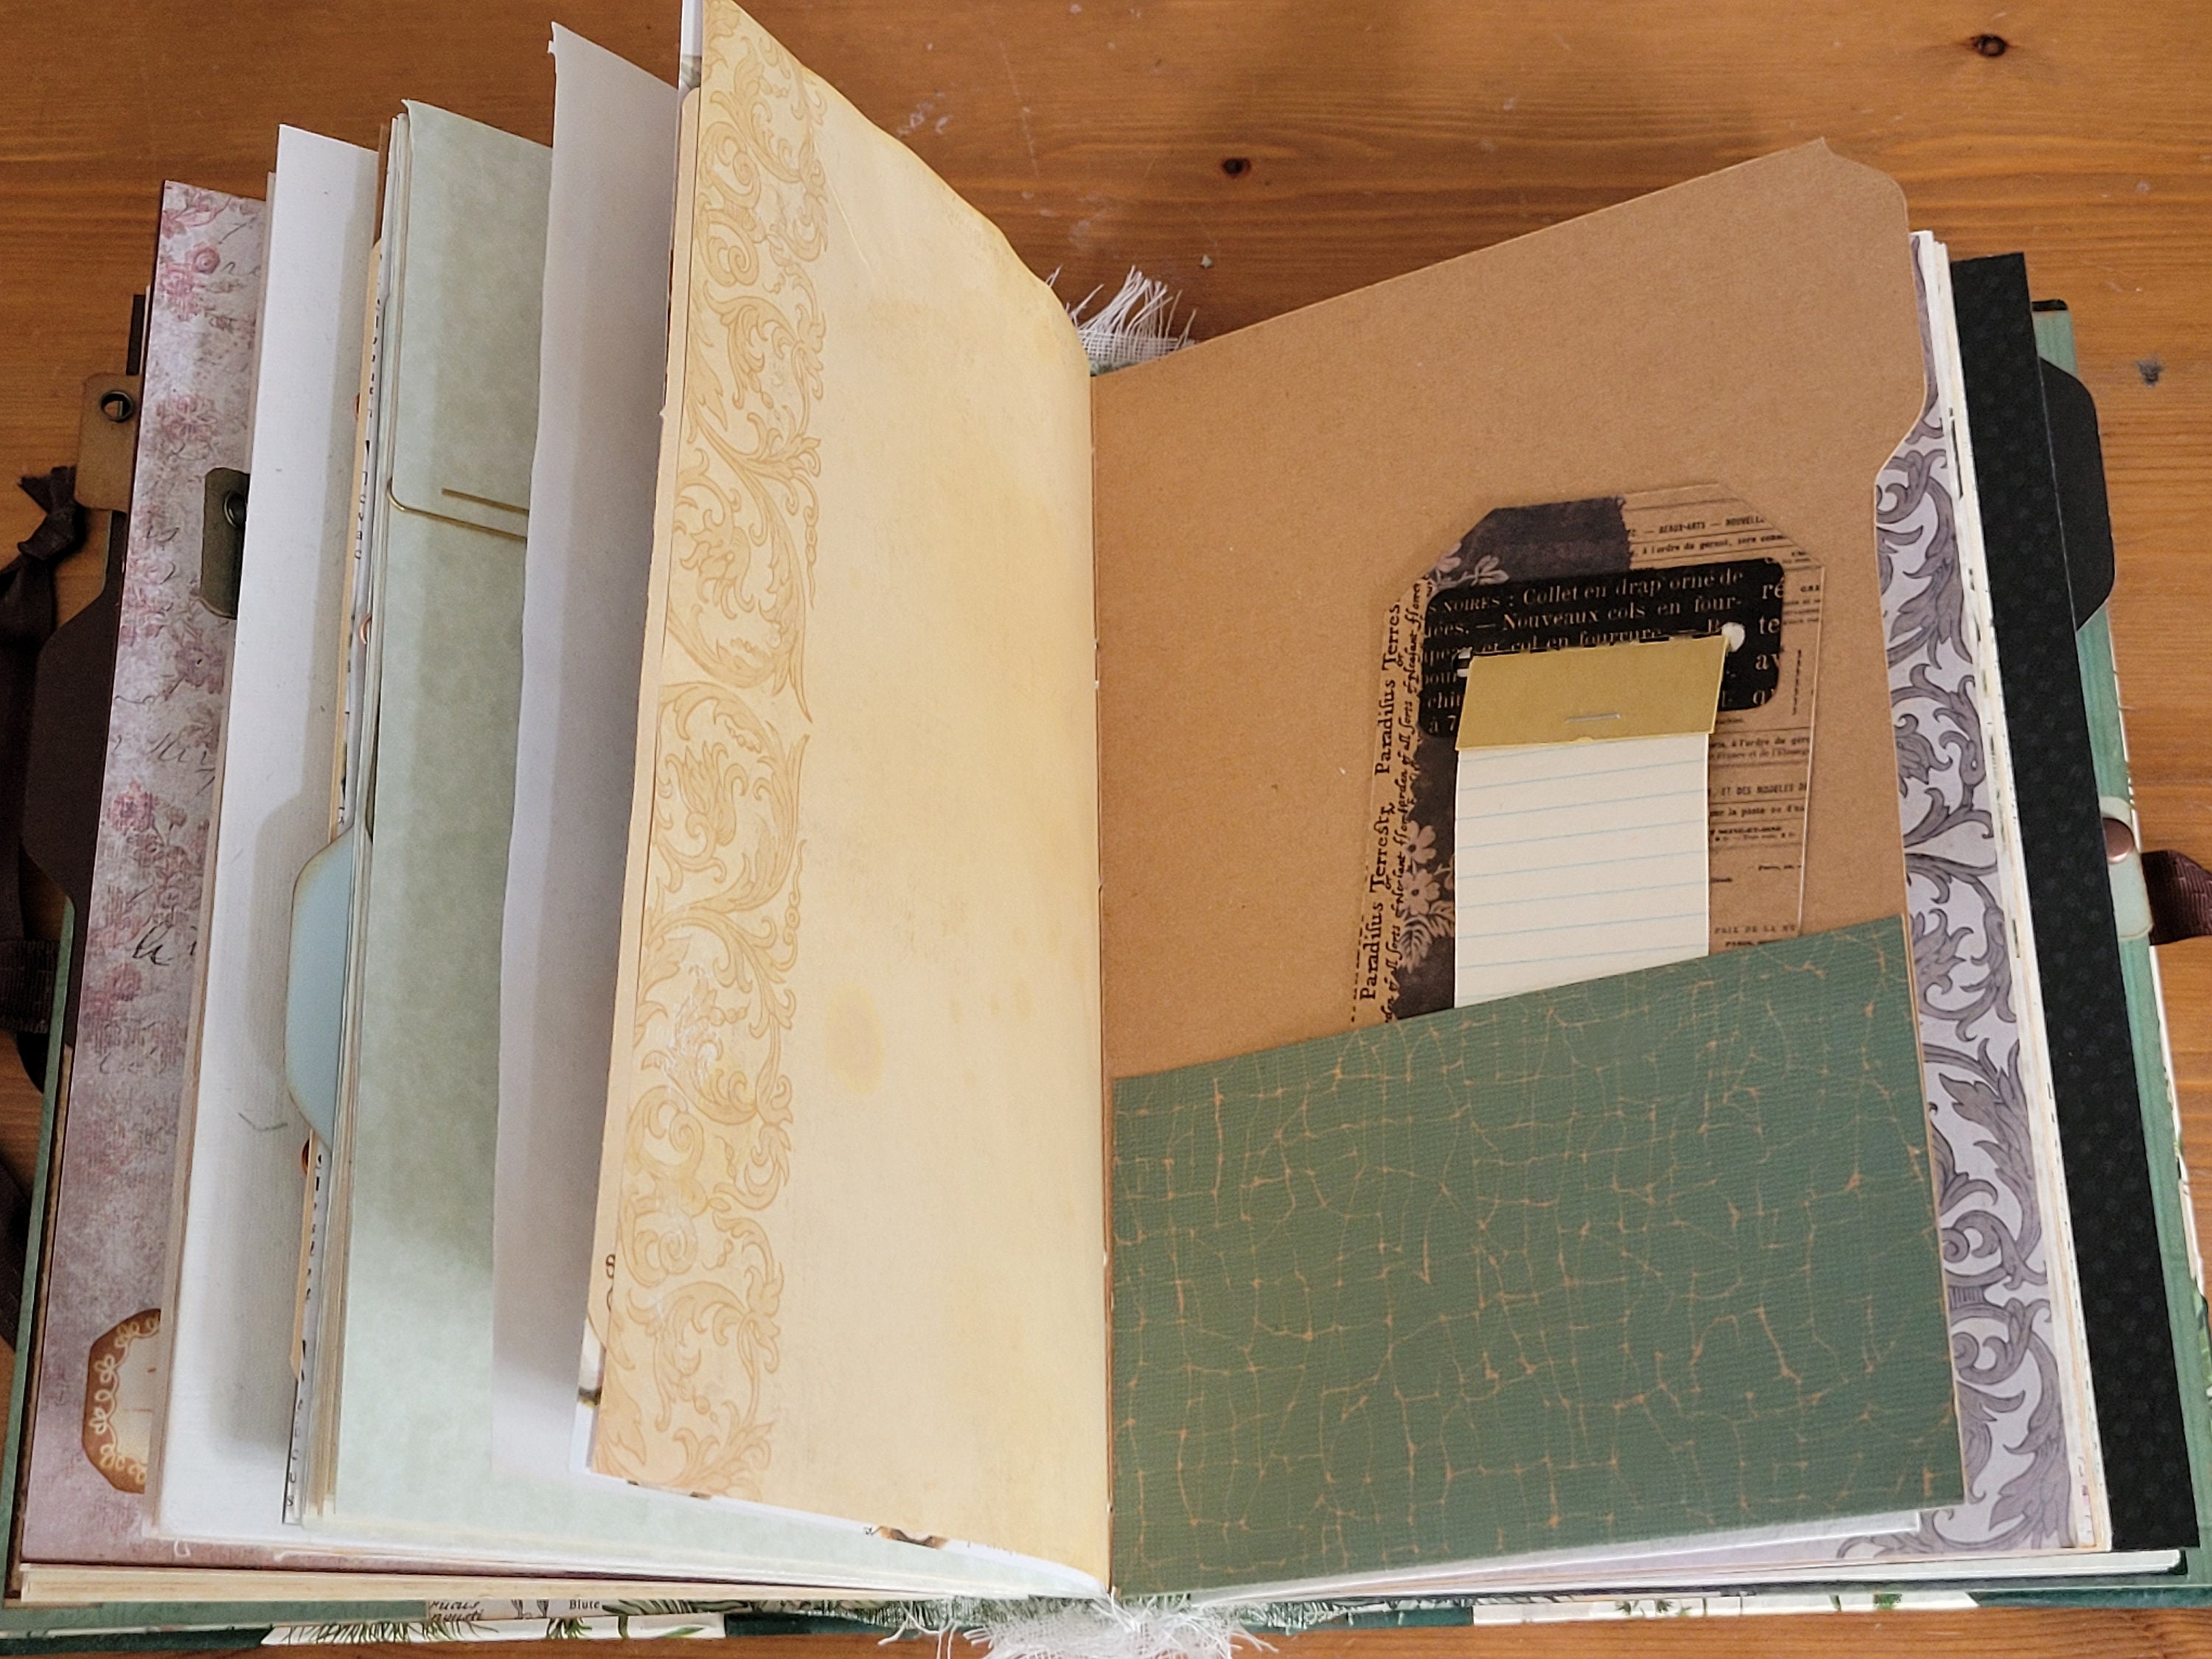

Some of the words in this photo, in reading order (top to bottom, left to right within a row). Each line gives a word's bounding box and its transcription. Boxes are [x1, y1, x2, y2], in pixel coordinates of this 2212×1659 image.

[1443, 596, 1501, 613] NOIRES
[1523, 585, 1578, 605] Collet
[1584, 585, 1607, 599] en
[1615, 578, 1662, 597] drap
[1719, 567, 1744, 586] de
[1502, 608, 1599, 630] Nouveaux
[1607, 601, 1646, 620] cols
[1658, 602, 1681, 616] en
